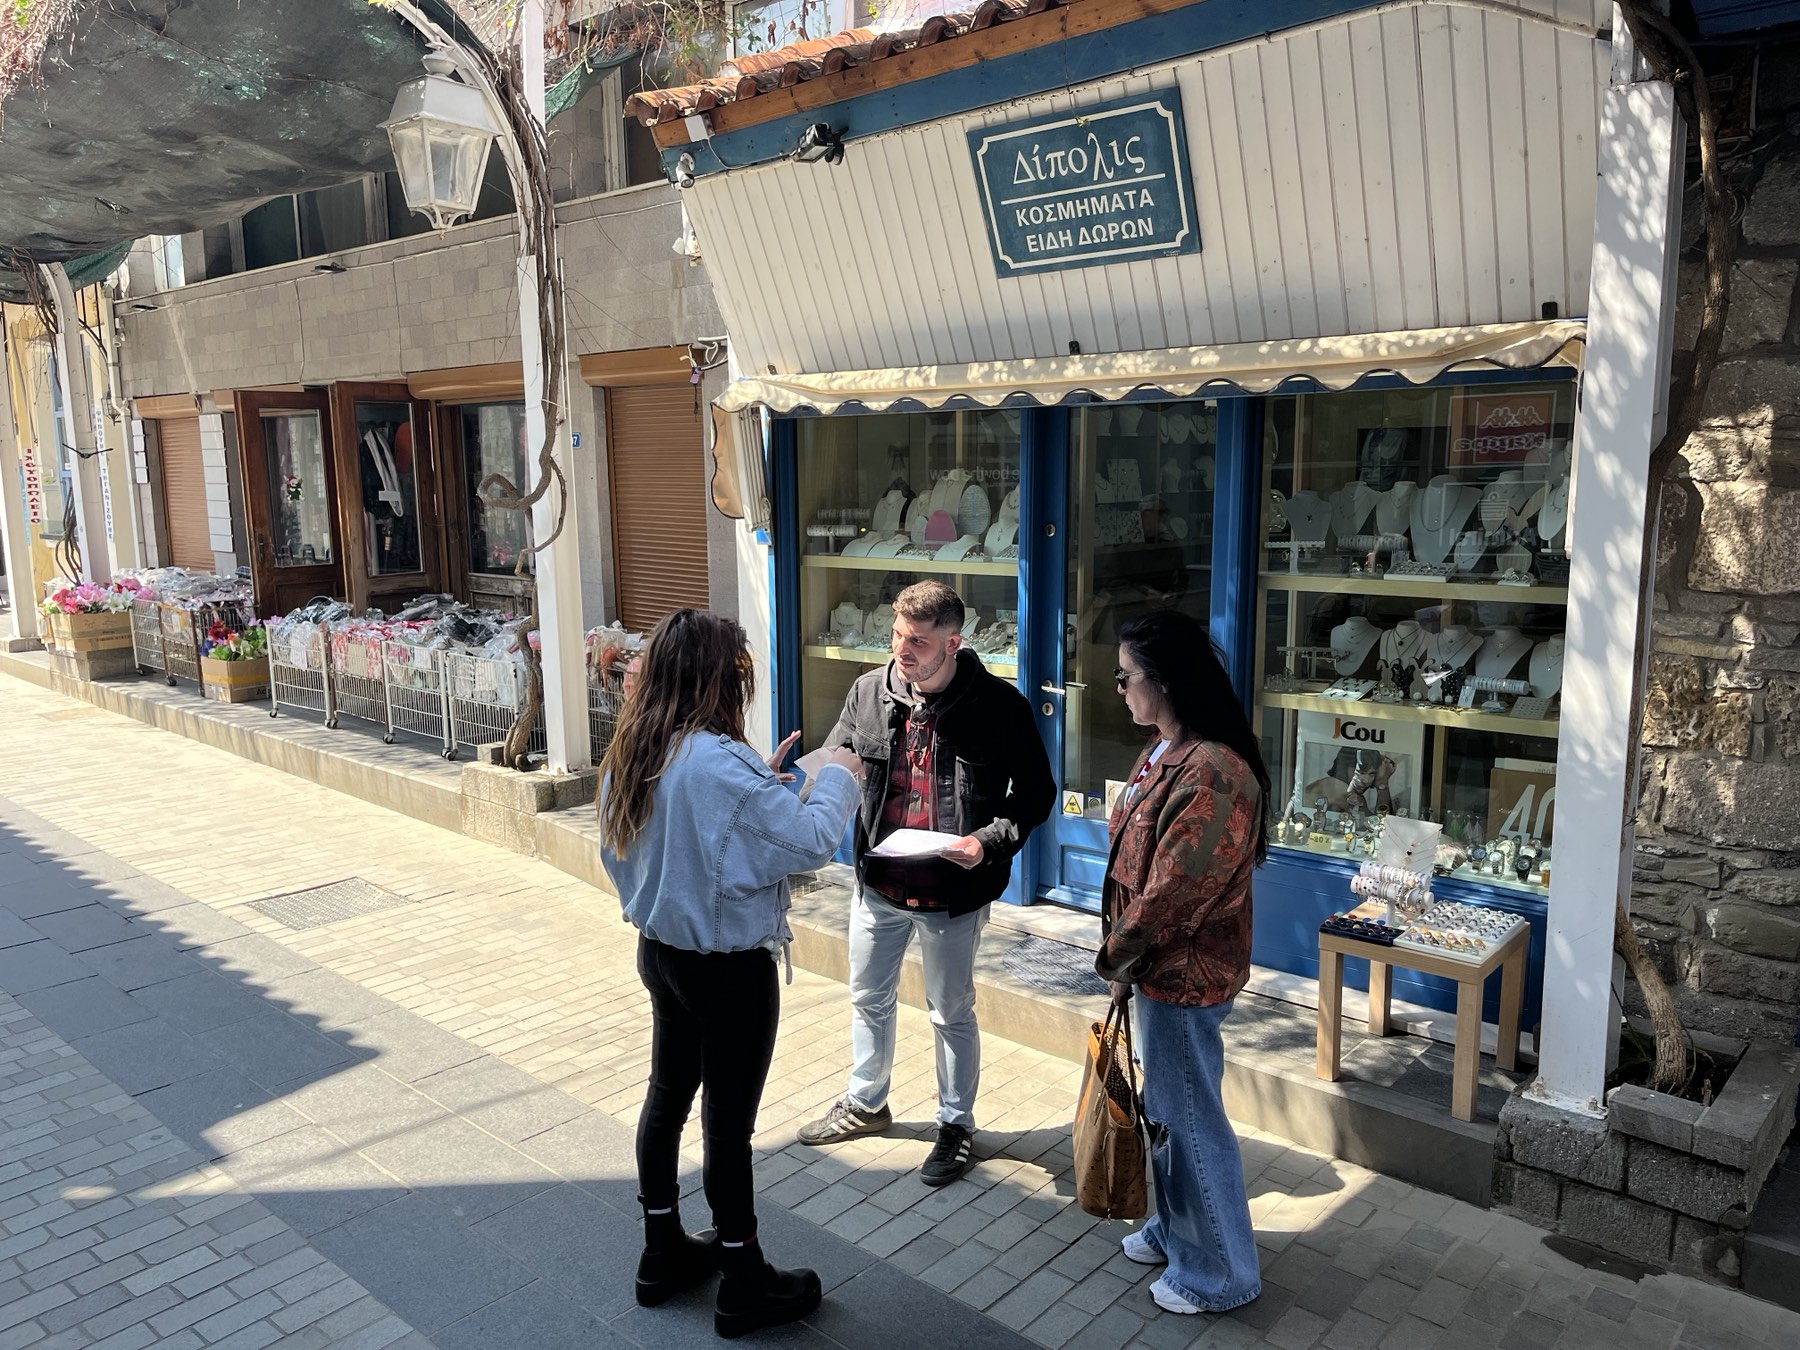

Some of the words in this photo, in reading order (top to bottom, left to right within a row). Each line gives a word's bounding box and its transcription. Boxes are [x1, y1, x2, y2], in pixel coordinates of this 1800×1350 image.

[1013, 132, 1145, 185] Δίπολις
[1016, 188, 1155, 227] ΚΟΣΜΗΜΑΤΑ
[1026, 229, 1073, 253] ΕΙΔΗ
[1078, 217, 1154, 246] ΔΩΡΩΝ
[1332, 717, 1386, 744] JCou
